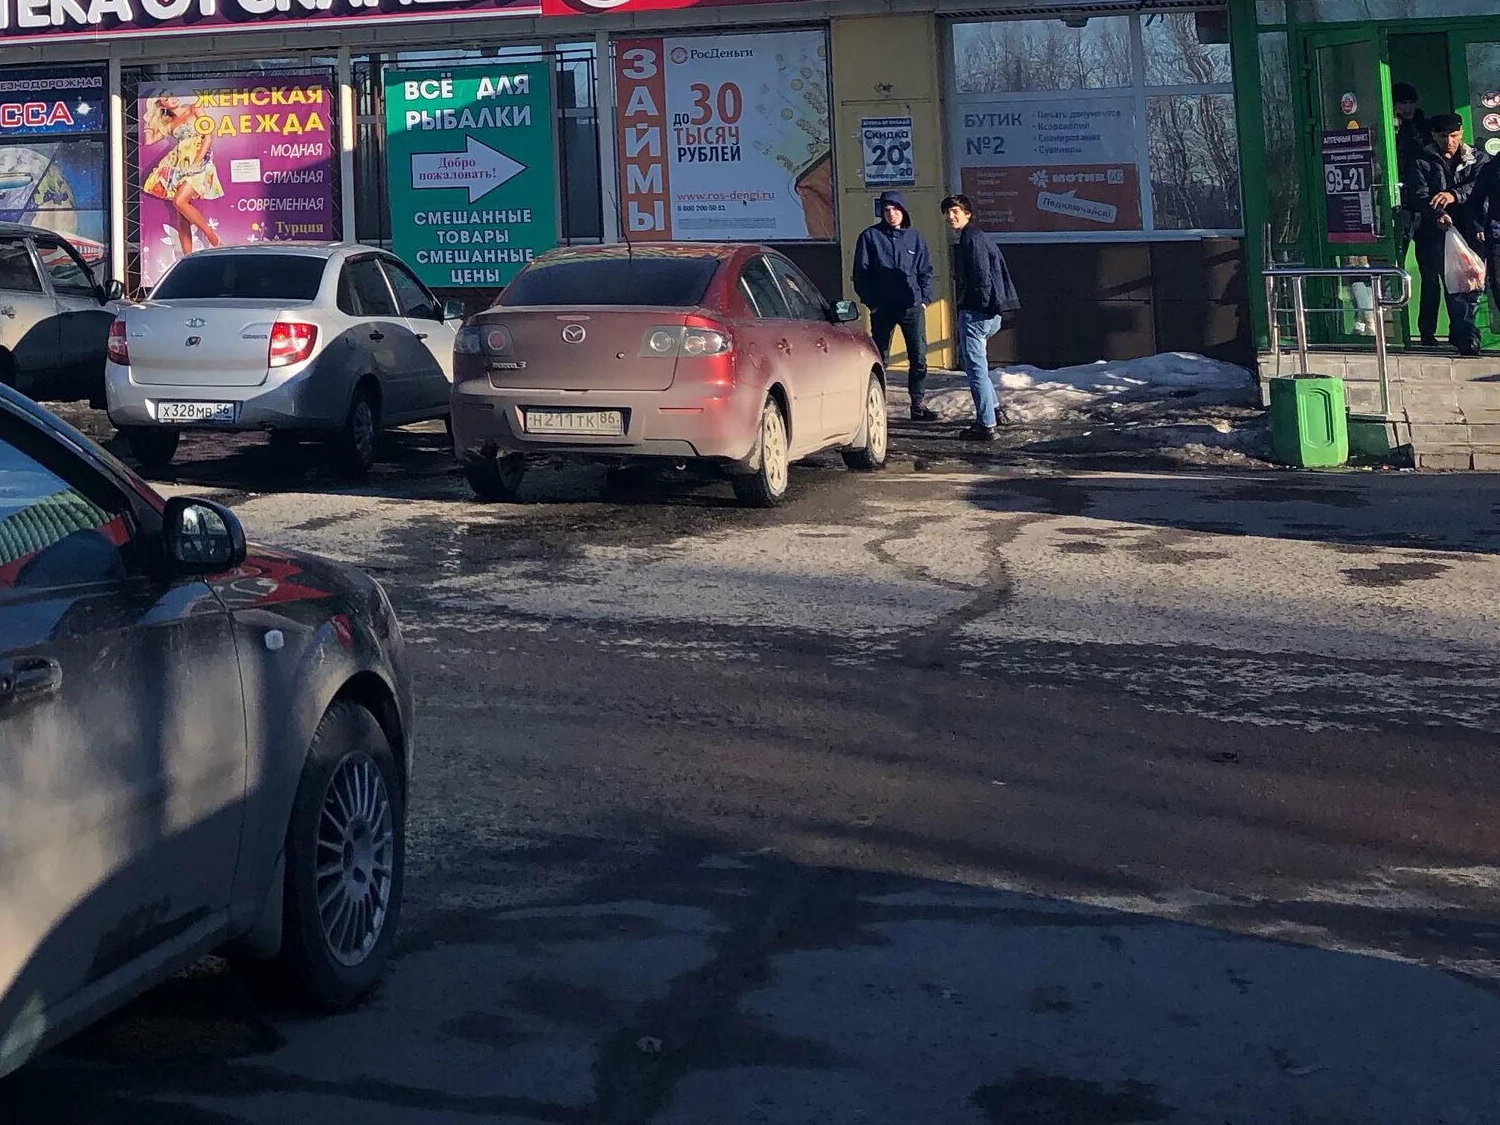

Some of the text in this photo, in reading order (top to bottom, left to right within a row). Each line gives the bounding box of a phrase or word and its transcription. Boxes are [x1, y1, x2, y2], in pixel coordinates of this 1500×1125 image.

[690, 48, 753, 60] РосДеньги
[404, 73, 530, 101] ВСЁ ДЛЯ
[194, 85, 324, 108] ЖЕНСКАЯ
[690, 81, 743, 126] 30
[194, 113, 325, 137] ОДЕЖДА
[406, 105, 532, 131] РЫБАЛКИ
[964, 112, 1023, 128] БУТИК
[622, 48, 665, 232] ЗАЙМЫ
[673, 126, 740, 146] ТЫСЯЧ
[864, 130, 909, 141] Скидка
[270, 143, 323, 159] МОДНАЯ
[678, 143, 741, 164] РУБЛЕЙ
[966, 136, 1005, 156] №2
[872, 145, 904, 165] 20
[438, 157, 476, 170] Добро
[263, 171, 324, 184] СТИЛЬНАЯ
[419, 167, 497, 181] пожаловать!
[677, 190, 775, 202] www.ros-dengi.ru
[238, 198, 324, 212] СОВРЕМЕННАЯ
[1042, 197, 1111, 218] Подключайся!
[414, 209, 532, 226] СМЕШАННЫЕ
[275, 221, 324, 236] Турция
[437, 230, 509, 244] ТОВАРЫ
[416, 248, 534, 265] СМЕШАННЫЕ
[451, 269, 500, 284] ЦЕНЫ
[216, 404, 230, 414] 56
[600, 412, 615, 424] 86
